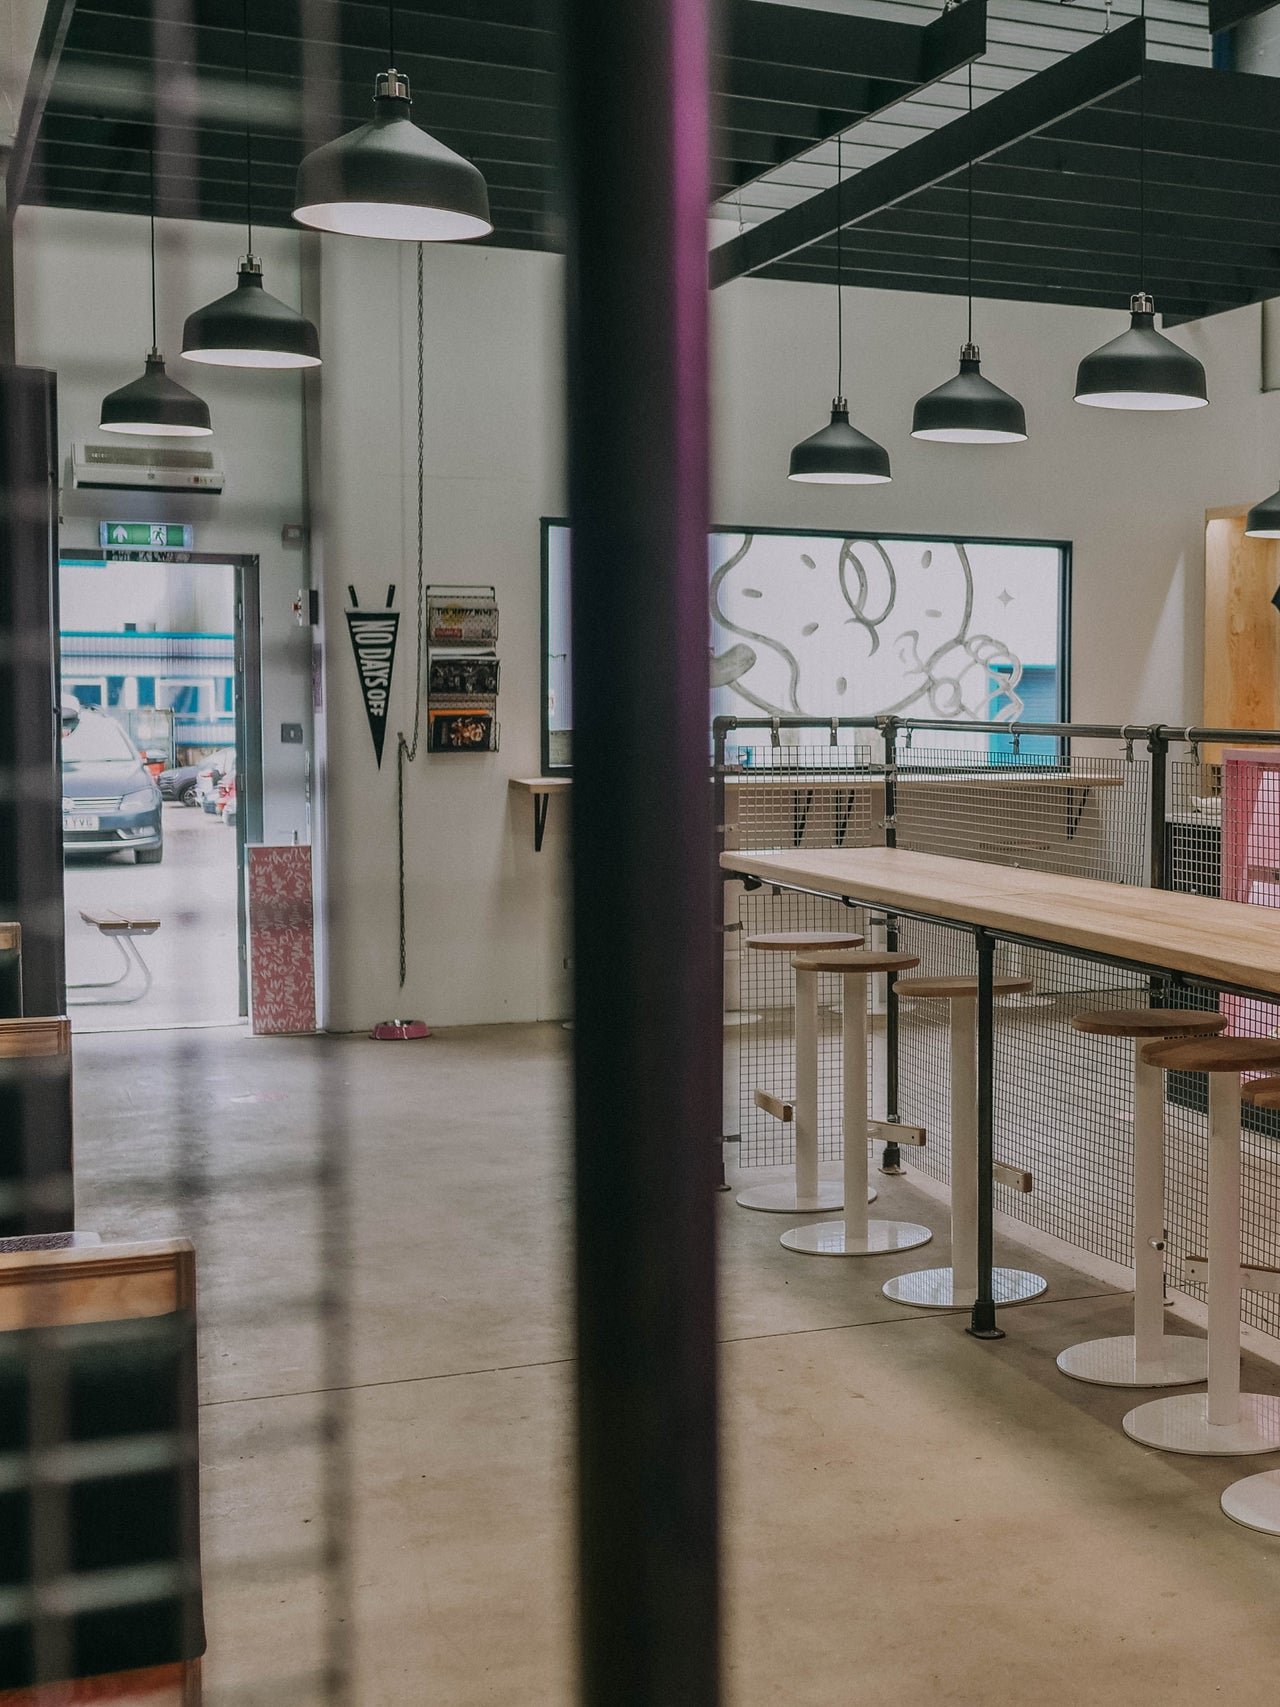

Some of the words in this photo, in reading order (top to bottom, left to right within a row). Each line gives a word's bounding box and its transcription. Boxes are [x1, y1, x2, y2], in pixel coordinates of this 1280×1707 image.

[350, 620, 397, 645] NO
[358, 647, 392, 687] DAYS
[366, 688, 388, 717] OFF
